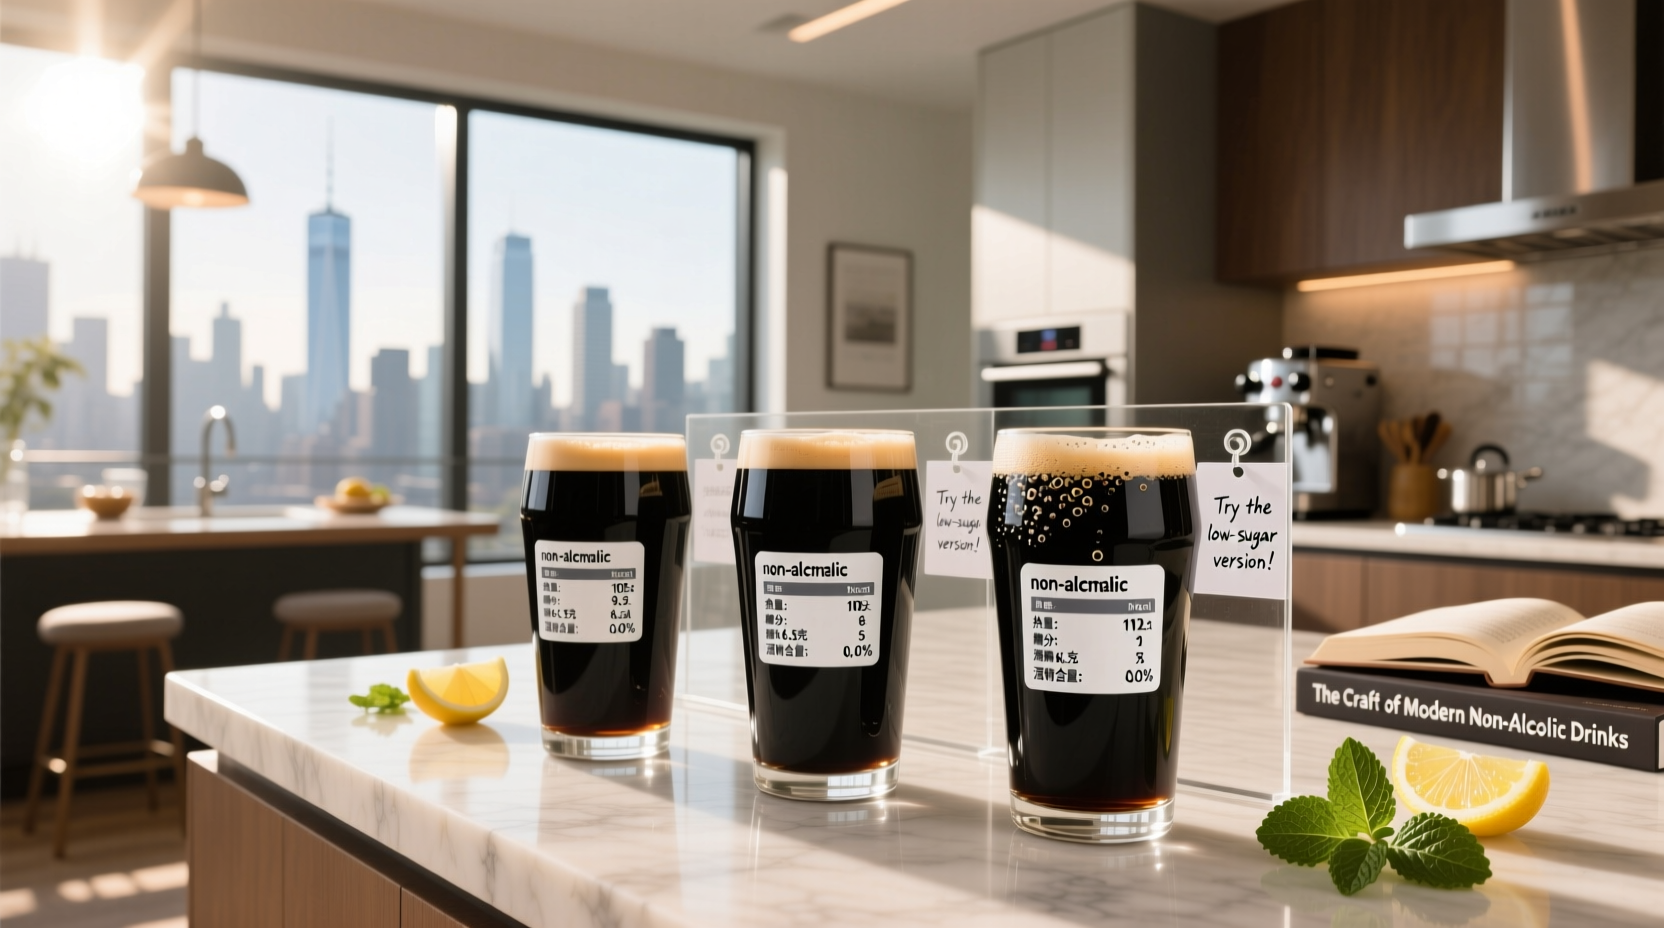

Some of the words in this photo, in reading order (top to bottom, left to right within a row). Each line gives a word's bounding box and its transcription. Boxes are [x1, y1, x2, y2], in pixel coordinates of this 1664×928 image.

[936, 489, 957, 512] Try
[962, 490, 981, 505] the
[1214, 496, 1240, 523] Try
[1246, 496, 1272, 514] the
[1207, 523, 1278, 550] low-sugar
[1213, 550, 1275, 571] version!
[1312, 682, 1341, 705] The
[1343, 688, 1380, 711] Craft
[1384, 694, 1402, 714] of
[1404, 696, 1465, 724] Modern
[1469, 706, 1566, 740] Non-Alcolic
[1571, 721, 1629, 749] Drinks
